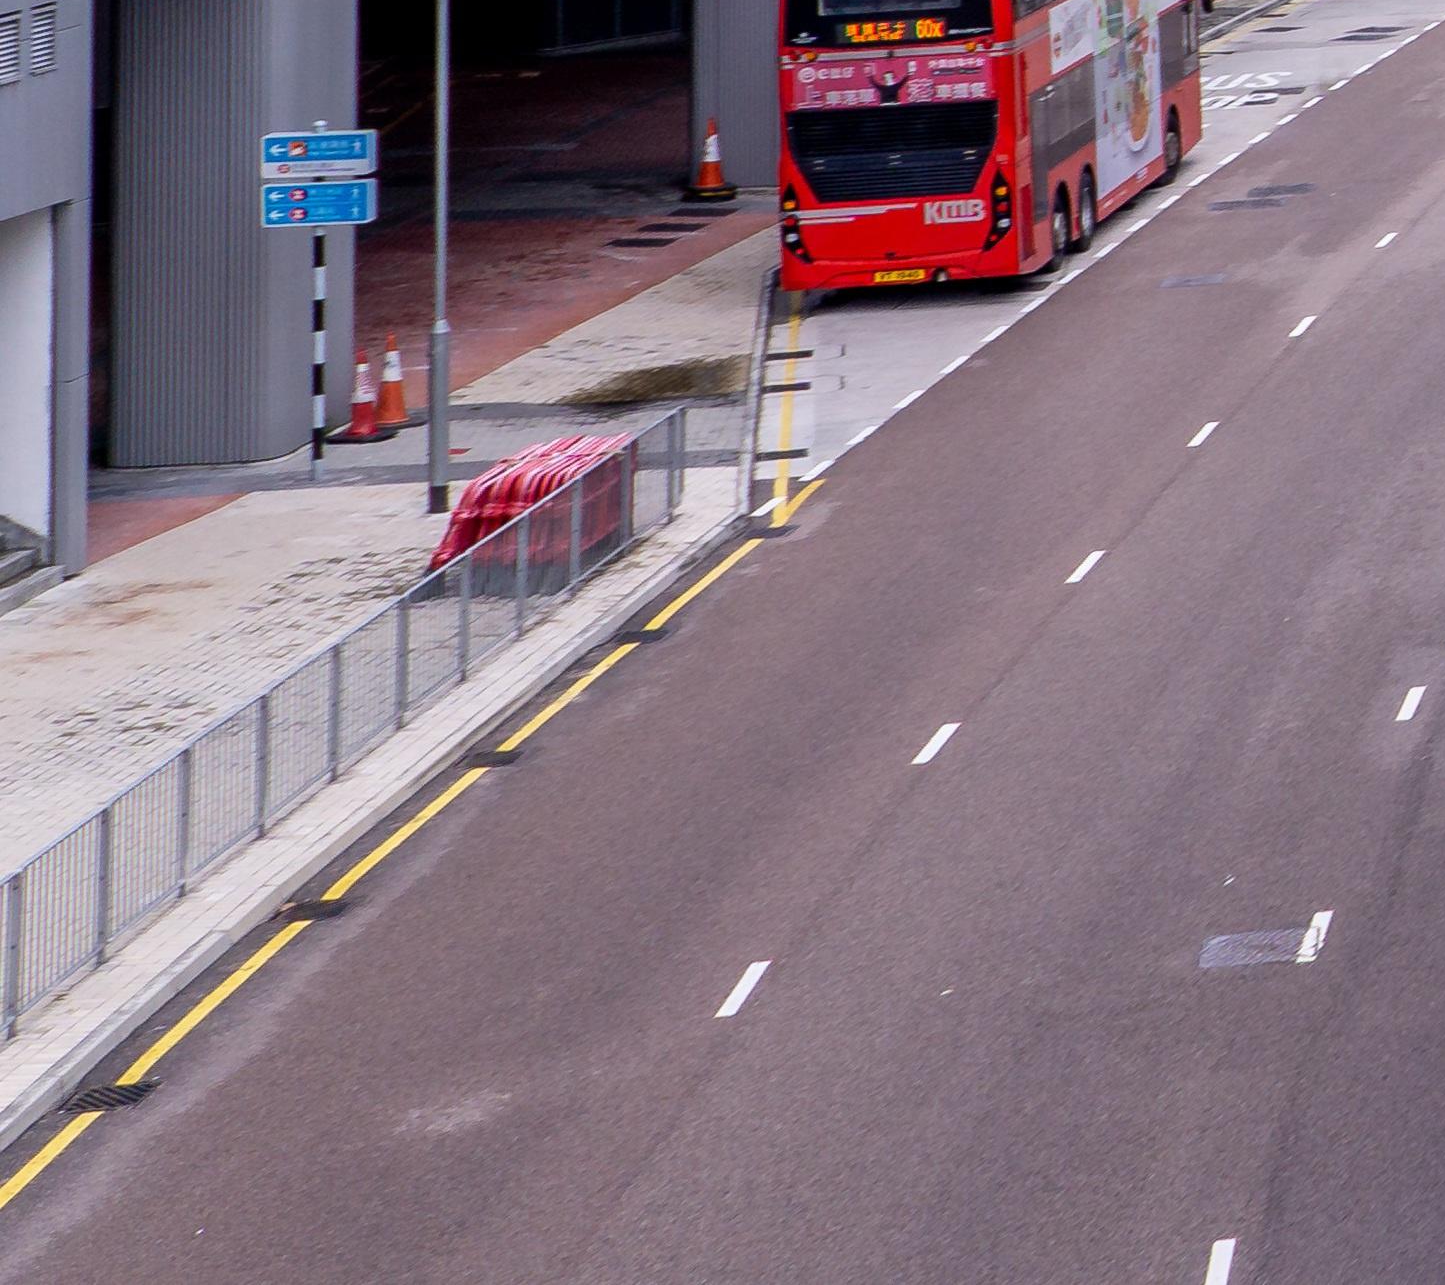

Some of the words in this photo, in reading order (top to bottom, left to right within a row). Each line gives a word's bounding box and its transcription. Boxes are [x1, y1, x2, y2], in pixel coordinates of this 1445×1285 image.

[1200, 71, 1293, 90] US
[1200, 92, 1280, 111] OP
[924, 199, 986, 225] KMB
